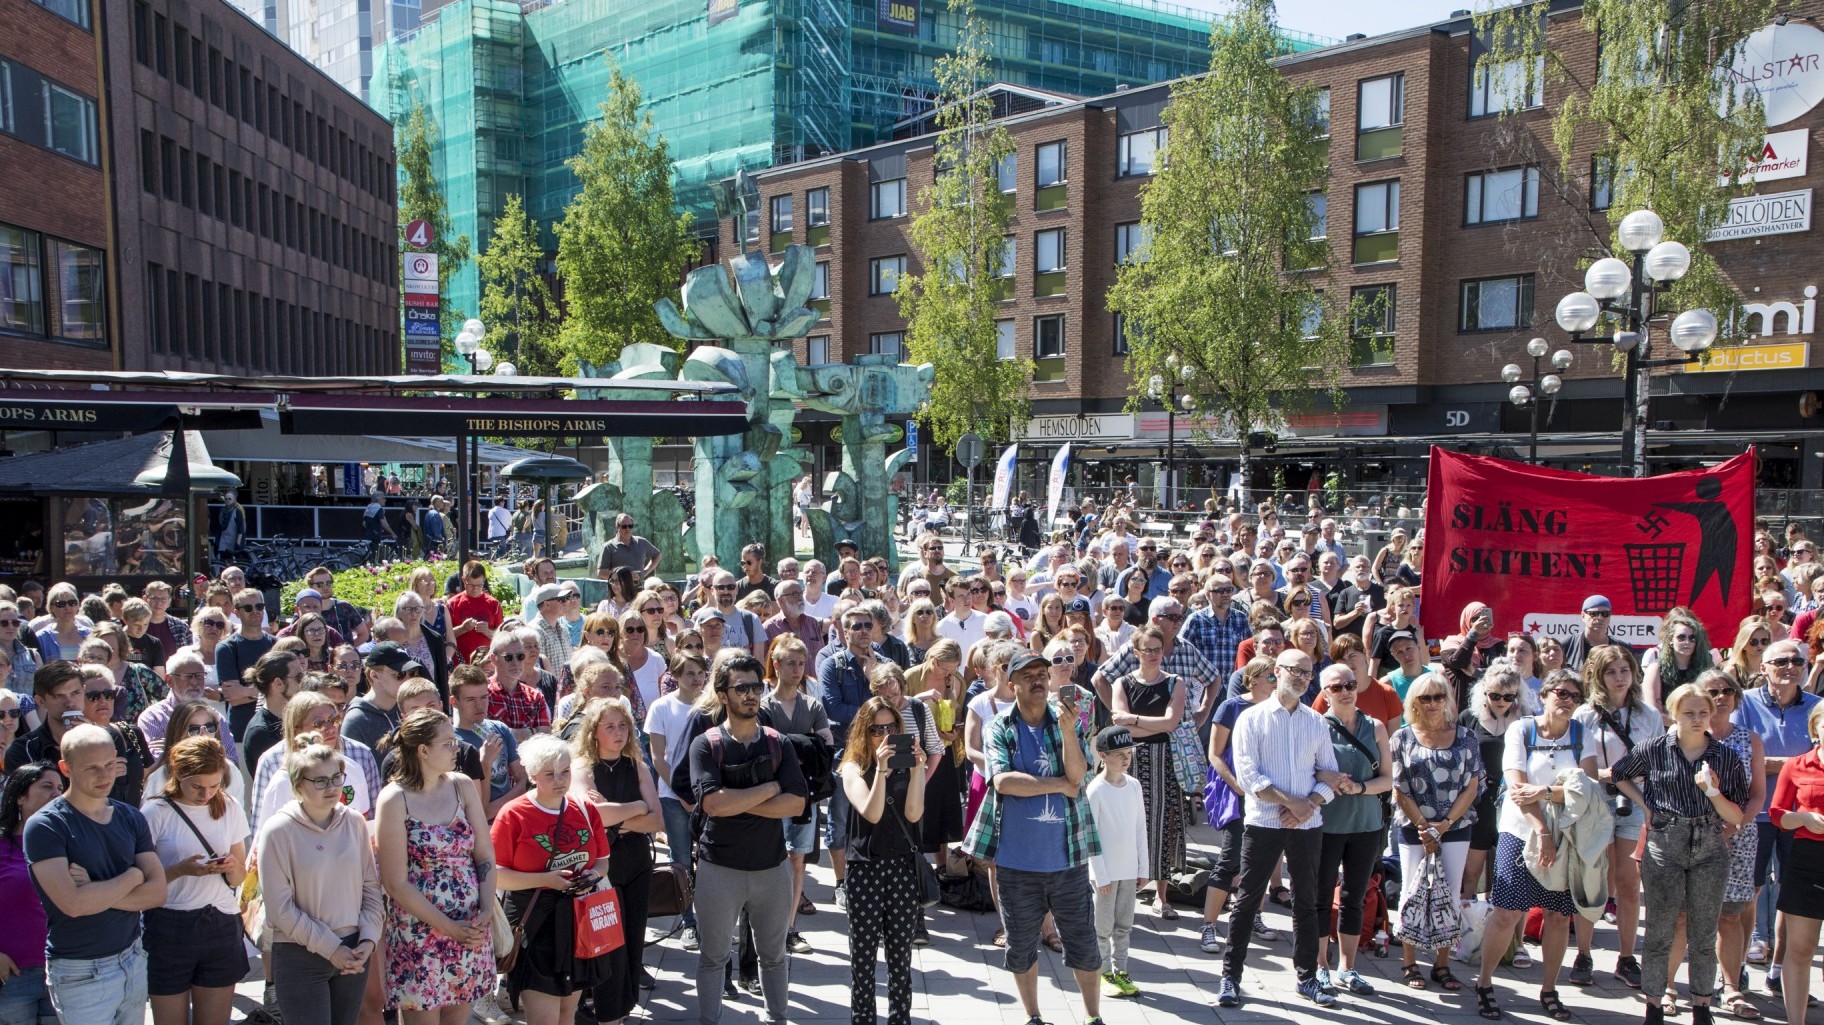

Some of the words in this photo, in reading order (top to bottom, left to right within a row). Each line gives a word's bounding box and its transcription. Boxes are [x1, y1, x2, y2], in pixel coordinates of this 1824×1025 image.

[890, 2, 916, 22] JIAB
[1725, 53, 1820, 86] ALLSTAR
[1713, 197, 1806, 226] MSLÖJDEN
[1722, 227, 1739, 237] OCH
[1741, 221, 1804, 235] KONSTHANTVERK
[1721, 285, 1819, 338] lmi
[40, 408, 97, 422] ARMS
[1446, 410, 1470, 427] 5D
[466, 419, 495, 430] THE
[498, 419, 560, 431] BISHOPS
[563, 420, 606, 431] ARMS
[1040, 414, 1101, 438] HEMSLÖJDEN
[1451, 501, 1567, 536] SLÄNG
[1450, 547, 1602, 579] SKITEN!
[1546, 623, 1580, 635] UNG
[1606, 624, 1656, 636] NSTER
[552, 853, 587, 868] ÄMLIKHET
[590, 912, 618, 931] VARANN
